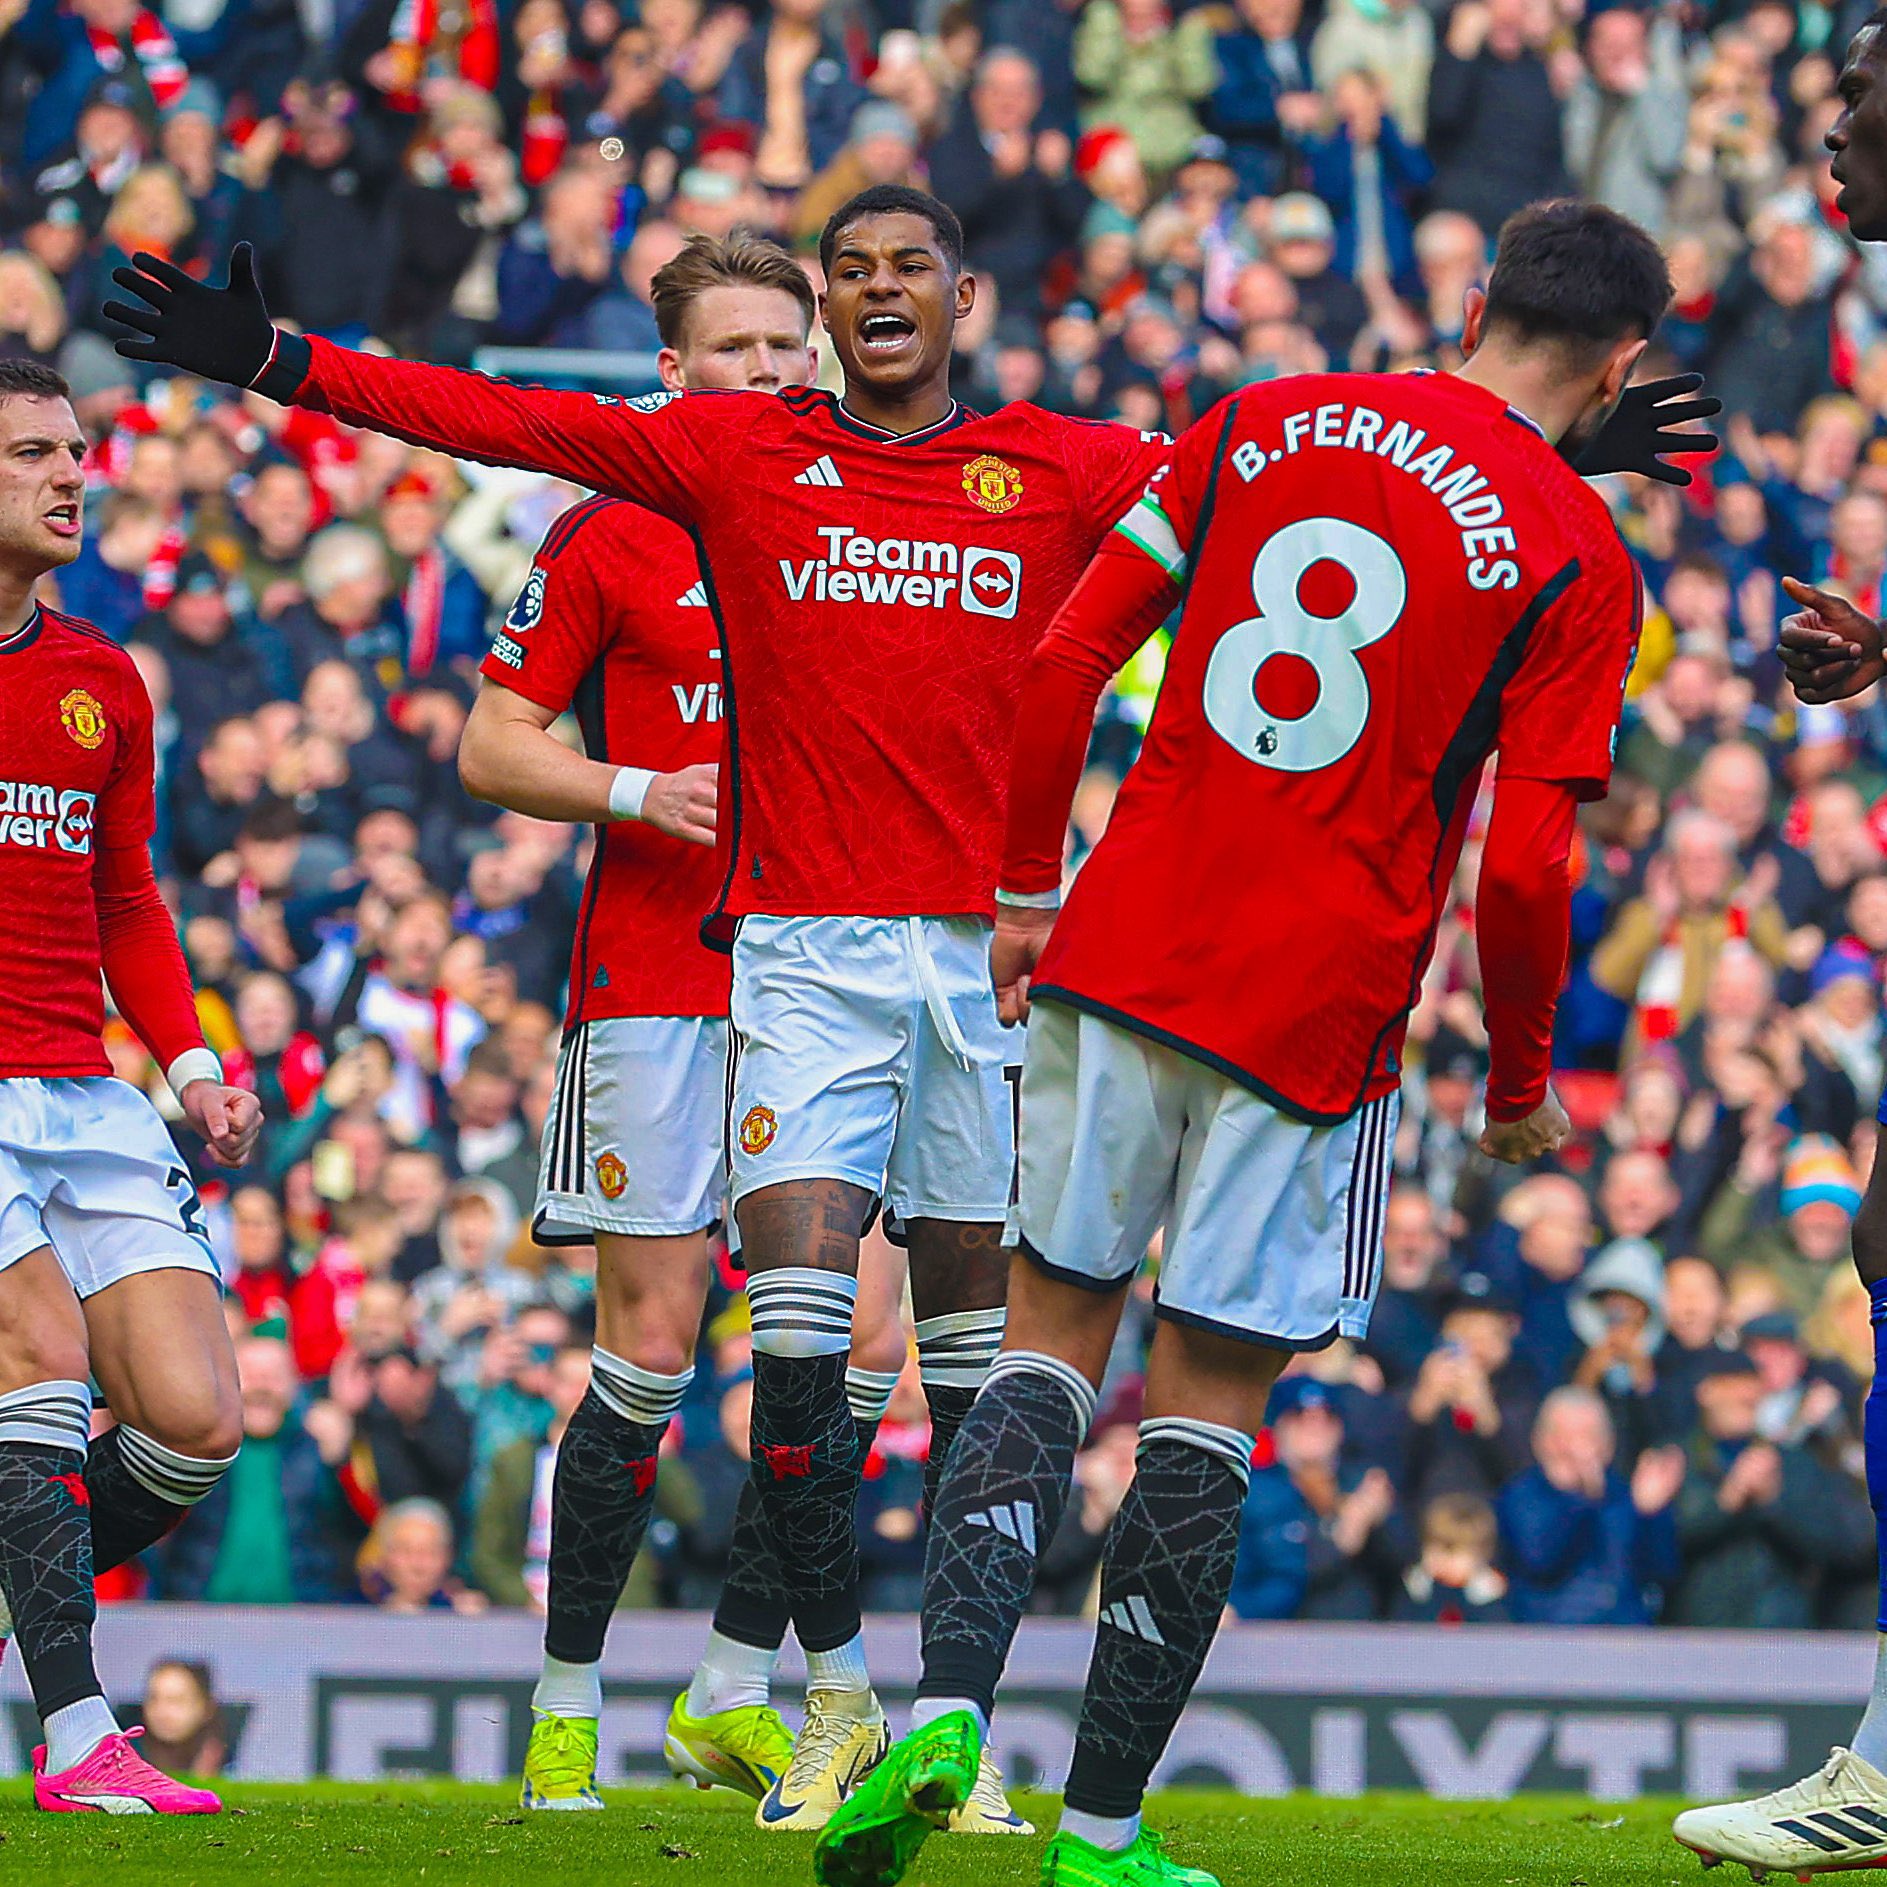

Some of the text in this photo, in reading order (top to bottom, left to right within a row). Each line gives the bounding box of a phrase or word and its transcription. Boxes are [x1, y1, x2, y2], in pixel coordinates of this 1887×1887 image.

[1231, 403, 1520, 590] B.FERNANDES
[817, 526, 959, 574] Team
[778, 559, 957, 609] Viewer
[1204, 516, 1407, 772] 8
[671, 682, 725, 724] Vi
